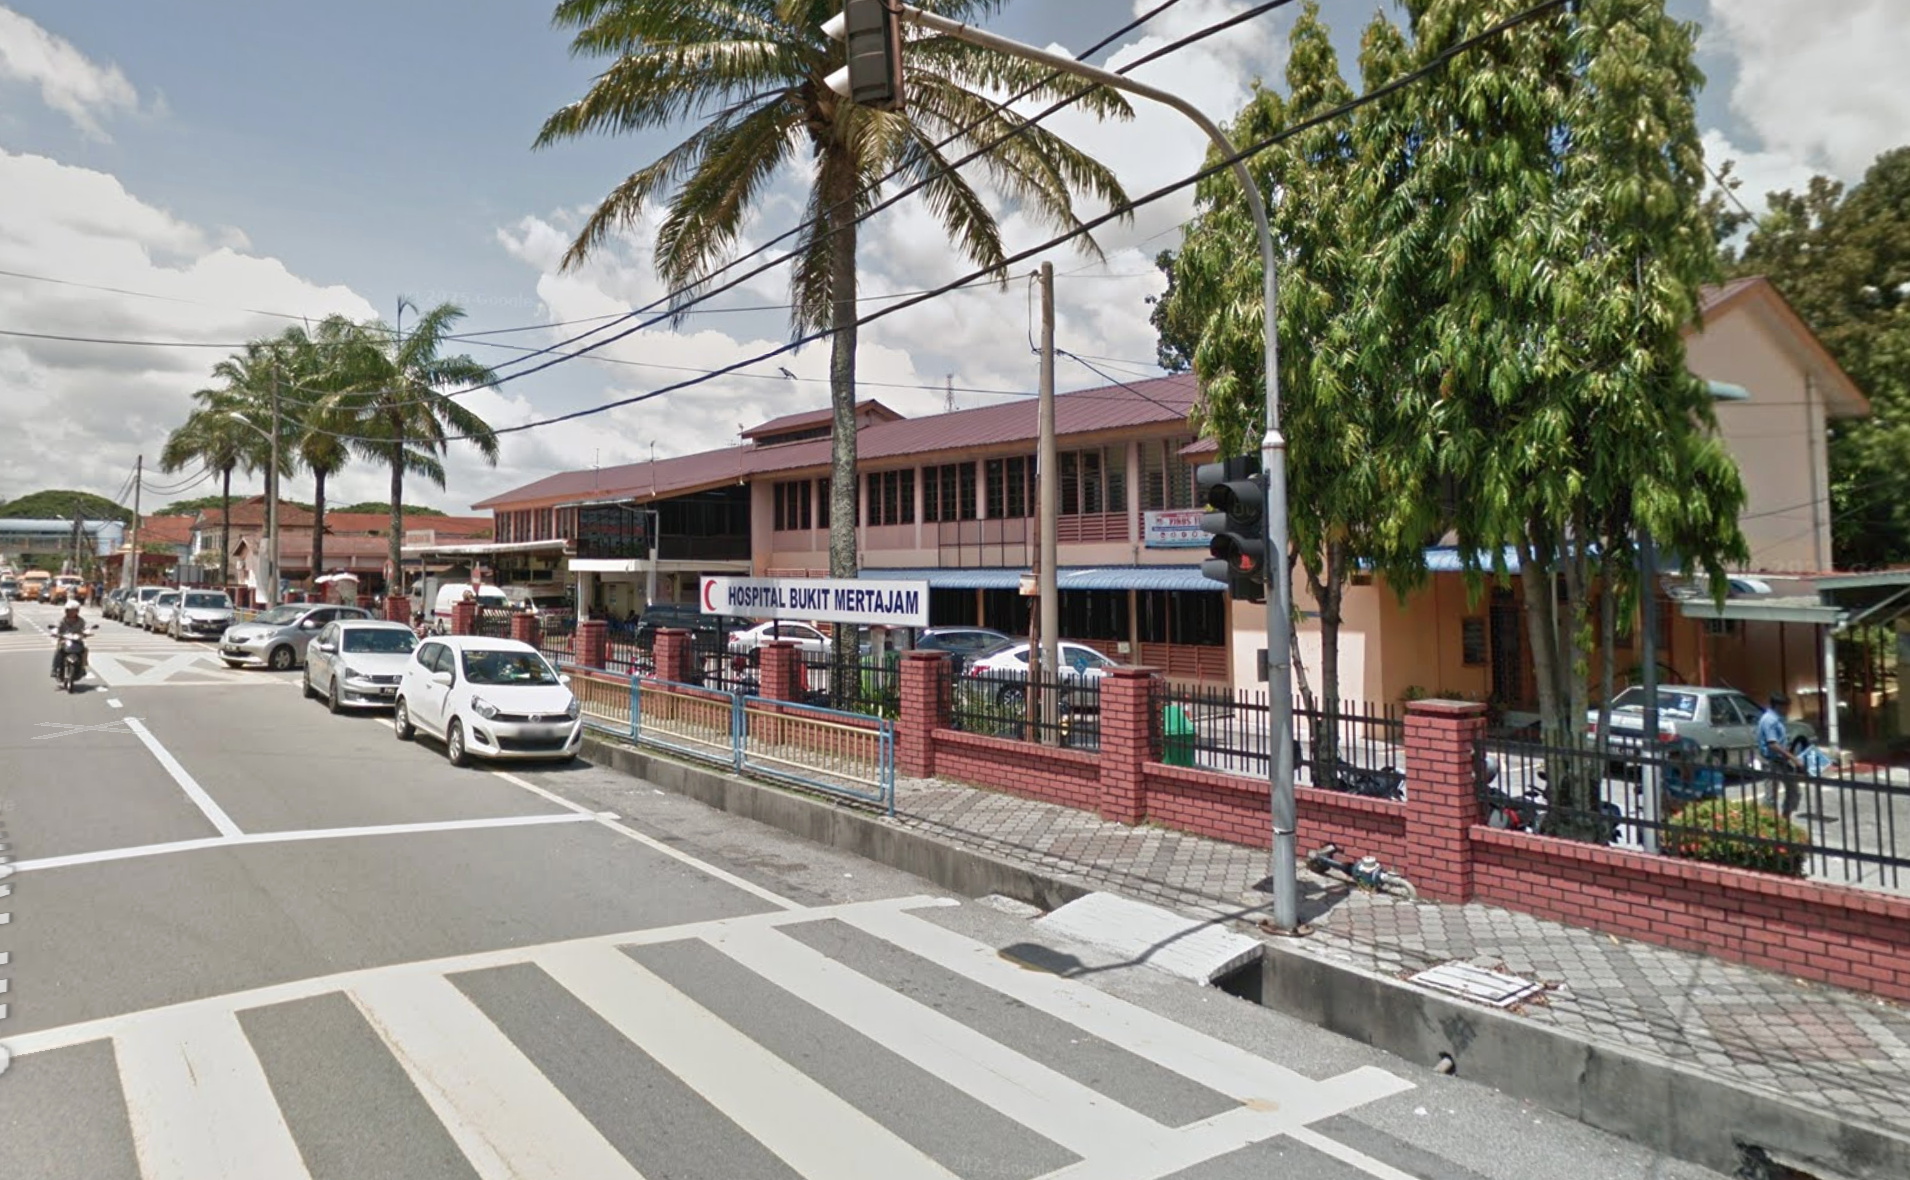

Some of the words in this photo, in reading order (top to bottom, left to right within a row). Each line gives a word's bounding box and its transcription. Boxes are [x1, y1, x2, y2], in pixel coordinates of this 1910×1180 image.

[728, 586, 786, 609] HOSPITAL
[789, 588, 830, 611] BUKIT
[834, 589, 919, 614] MERTAJAM
